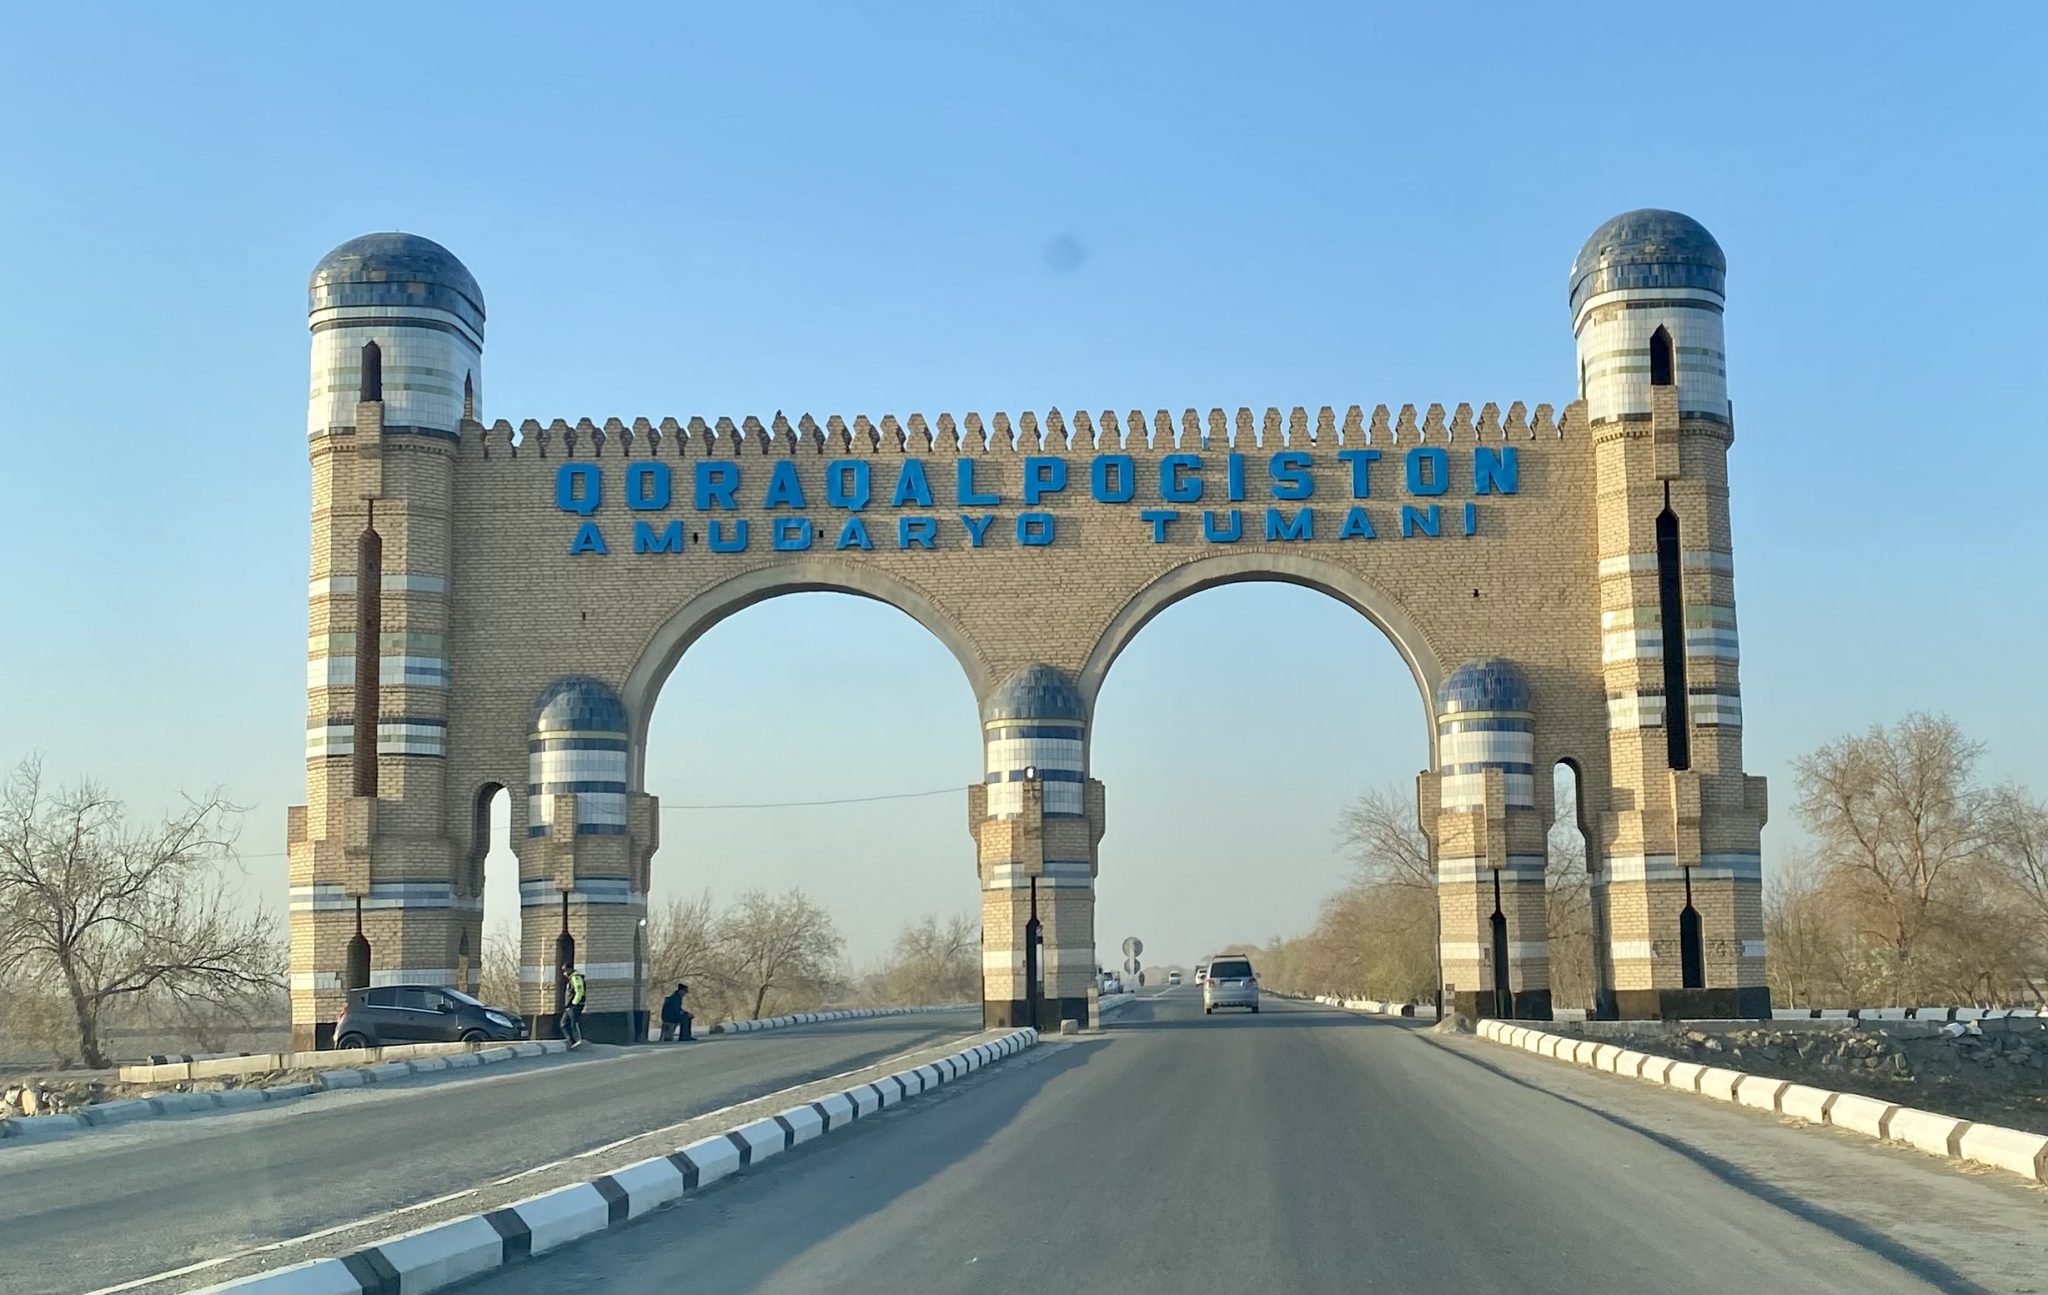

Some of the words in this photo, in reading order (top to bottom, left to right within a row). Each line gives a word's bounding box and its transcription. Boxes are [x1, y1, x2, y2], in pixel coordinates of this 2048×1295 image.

[554, 447, 1519, 517] QORAQALPOGISTON
[570, 512, 1055, 556] AMUDARYO
[1141, 503, 1477, 544] TUMANI
